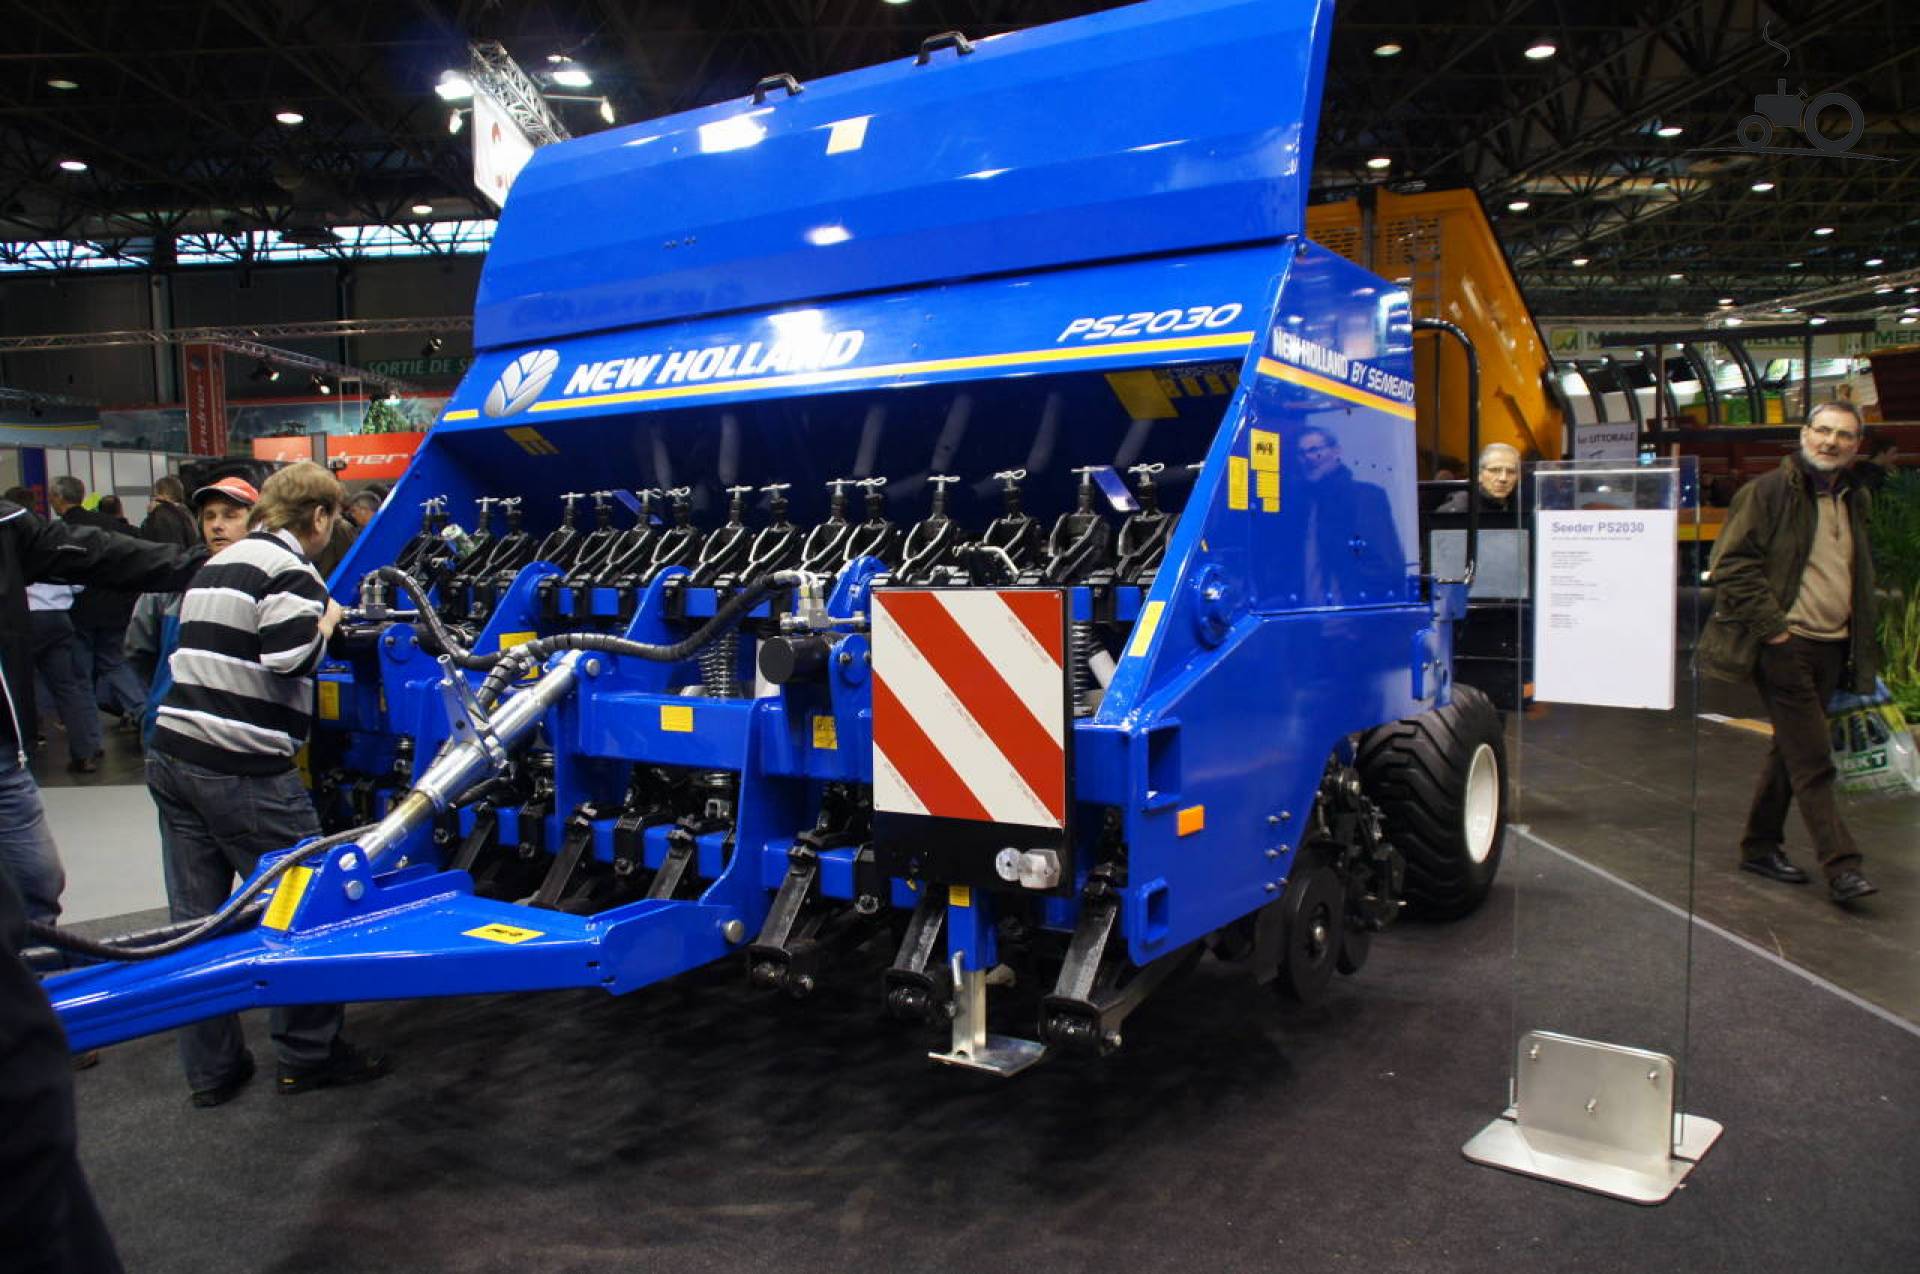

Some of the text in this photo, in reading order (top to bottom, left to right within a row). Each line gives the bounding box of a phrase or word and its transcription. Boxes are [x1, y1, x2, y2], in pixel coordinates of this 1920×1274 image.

[1056, 302, 1243, 343] PS2030
[367, 359, 424, 377] SORTIE
[429, 358, 450, 373] DE
[563, 353, 662, 395] NEW
[1352, 361, 1367, 384] BY
[275, 451, 409, 468] Ldner
[1551, 521, 1645, 533] Seeder PS2030
